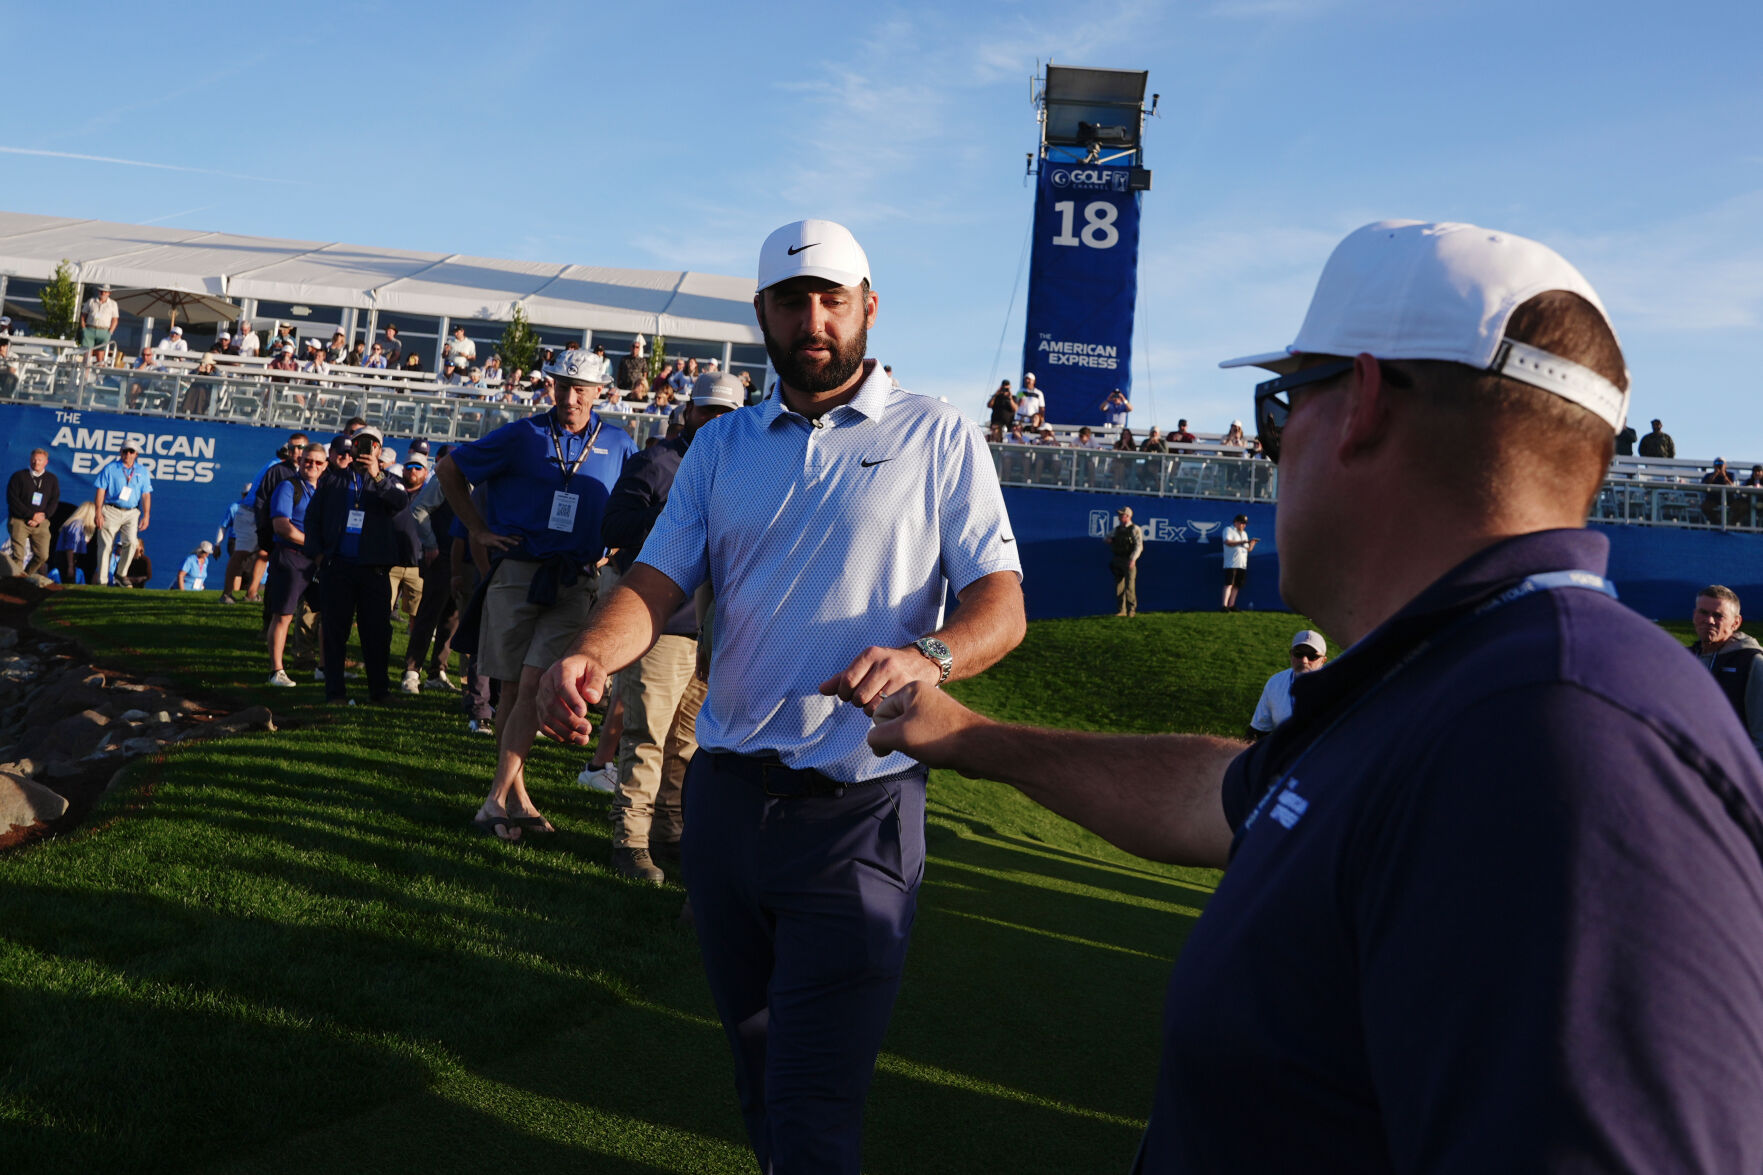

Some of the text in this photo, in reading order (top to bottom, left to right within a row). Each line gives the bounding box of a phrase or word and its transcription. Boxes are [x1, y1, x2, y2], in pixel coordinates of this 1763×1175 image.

[1070, 170, 1112, 184] GOLF
[1052, 200, 1119, 249] 18
[1038, 332, 1052, 340] THE
[1038, 340, 1117, 357] AMERICAN
[1048, 353, 1118, 370] EXPRESS
[55, 411, 81, 425] THE
[51, 426, 216, 459] AMERICAN
[71, 452, 215, 483] EXRESS
